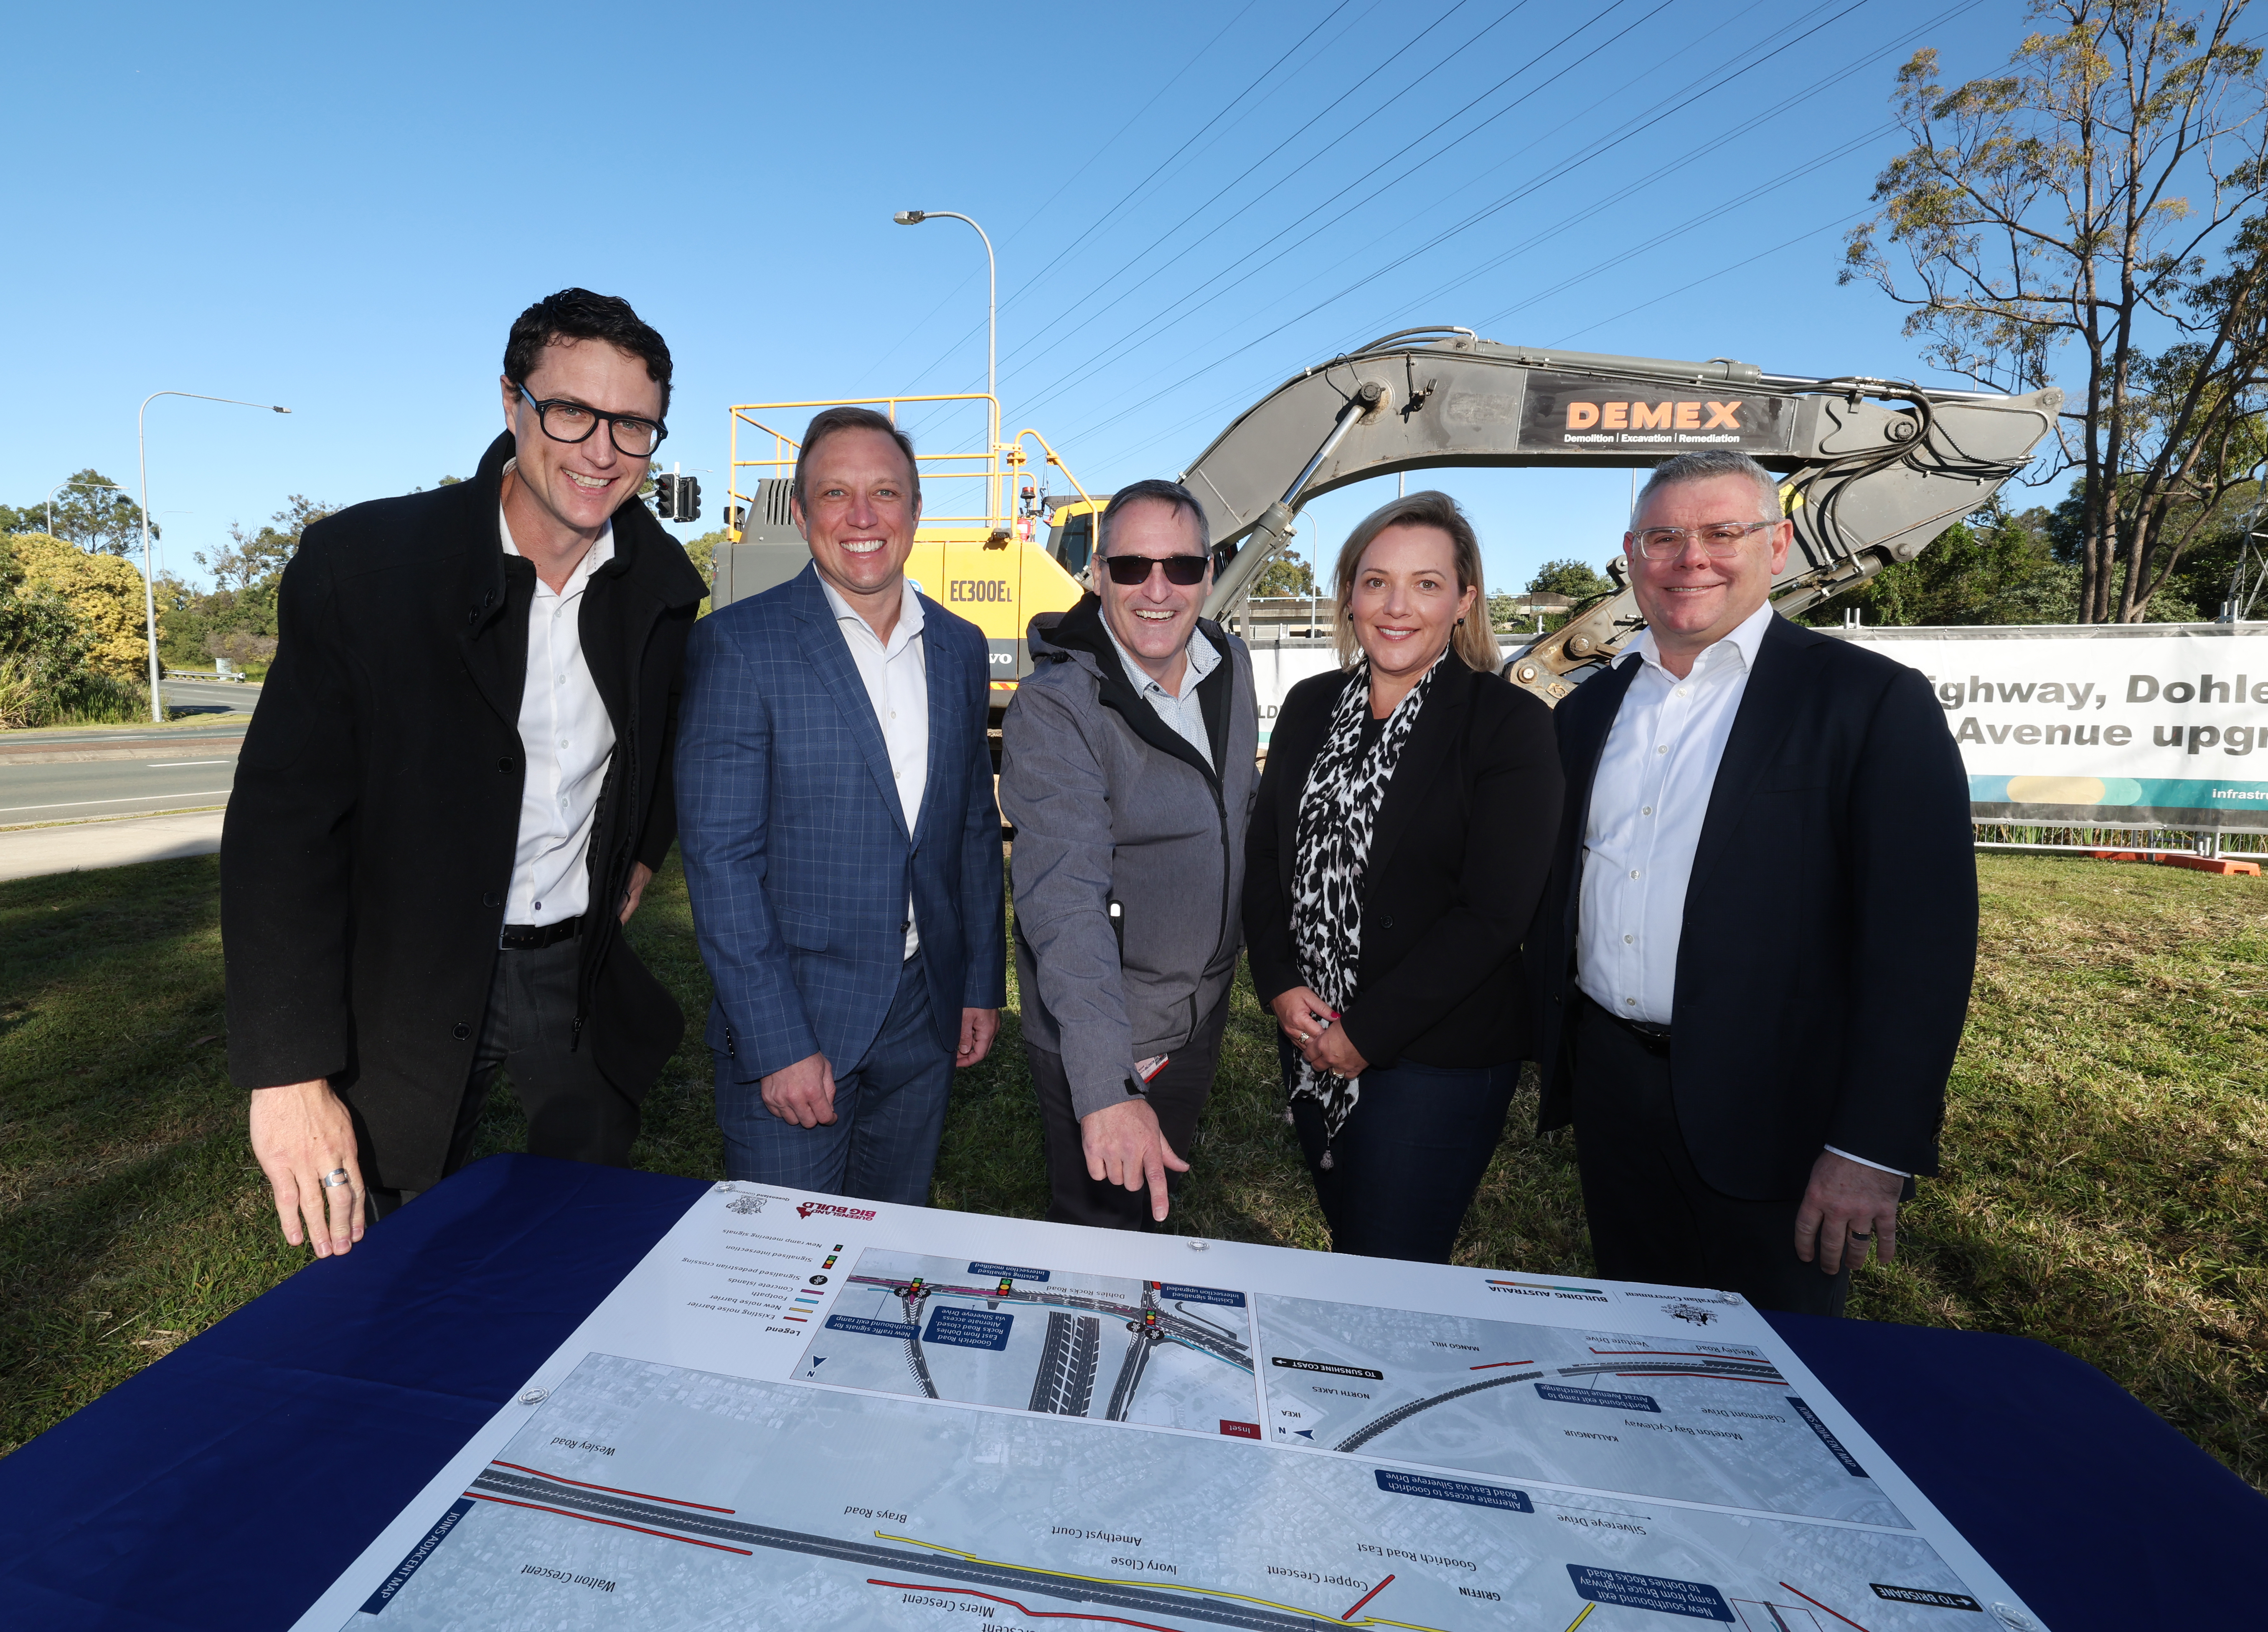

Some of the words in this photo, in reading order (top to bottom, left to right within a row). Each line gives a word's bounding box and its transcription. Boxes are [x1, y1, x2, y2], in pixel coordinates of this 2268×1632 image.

[1566, 402, 1742, 430] DEMEX
[1564, 434, 1614, 442] Demolition
[1621, 434, 1671, 442] Excavation
[1679, 434, 1740, 442] Remediation
[989, 653, 1012, 664] VO
[1927, 675, 2106, 710] ighway,
[1955, 717, 2132, 745] Avenue
[2212, 789, 2268, 800] infrastr
[756, 1193, 790, 1202] Queensland
[802, 1202, 848, 1213] BUILD
[849, 1208, 876, 1218] BIG
[750, 1233, 783, 1242] metering
[726, 1245, 771, 1256] intersection
[681, 1258, 714, 1266] crossing
[772, 1253, 813, 1262] Signalised
[716, 1263, 758, 1273] pedestrian
[1006, 1267, 1045, 1275] intersection
[759, 1270, 801, 1280] Signalised
[727, 1278, 757, 1286] islands
[758, 1283, 793, 1292] Concrete
[751, 1291, 787, 1301] Footpath
[1096, 1290, 1125, 1299] Dohles
[1200, 1290, 1239, 1299] intersection
[1488, 1286, 1550, 1297] AUSTRALIA
[1625, 1292, 1681, 1302] Government
[709, 1295, 738, 1304] barrier
[1554, 1292, 1608, 1303] BUILDING
[1683, 1297, 1727, 1306] ustralian
[687, 1302, 716, 1311] barrier
[741, 1309, 775, 1319] Existing
[962, 1312, 993, 1320] Silvereye
[871, 1321, 914, 1330] southbound
[765, 1327, 801, 1336] Legend
[958, 1337, 991, 1346] Goodrich
[1585, 1335, 1610, 1344] Drive
[1612, 1337, 1649, 1348] Venture
[1449, 1343, 1479, 1352] MANGO
[1696, 1345, 1721, 1353] Road
[1722, 1345, 1757, 1357] Wesley
[1292, 1361, 1318, 1371] COAST
[1320, 1365, 1362, 1377] SUNSHINE
[1312, 1386, 1338, 1396] LAKES
[1341, 1389, 1370, 1400] NORTH
[1541, 1385, 1590, 1396] interchange
[1591, 1391, 1621, 1400] Avenue
[1599, 1399, 1650, 1410] Northbound
[1281, 1409, 1301, 1418] IKEA
[1701, 1408, 1727, 1418] Drive
[1728, 1411, 1785, 1423] Claremont
[1229, 1425, 1250, 1434] Inset
[1624, 1419, 1673, 1432] Cycleway
[1674, 1424, 1694, 1436] Bay
[1564, 1429, 1619, 1442] KALLANGUR
[1697, 1428, 1743, 1441] Moreton
[1796, 1406, 1817, 1423] JOINS
[1812, 1423, 1844, 1452] ADJACENT
[1837, 1452, 1856, 1467] MAP
[550, 1436, 578, 1449] Road
[579, 1441, 616, 1457] Wesley
[1386, 1473, 1409, 1482] Drive
[1412, 1477, 1453, 1489] Silvereye
[1389, 1482, 1431, 1495] Goodrich
[1433, 1489, 1442, 1497] to
[1471, 1486, 1491, 1495] East
[1493, 1489, 1517, 1499] Road
[1444, 1491, 1475, 1502] access
[1478, 1496, 1520, 1509] Alternate
[844, 1506, 873, 1519] Road
[876, 1509, 907, 1524] Brays
[434, 1512, 460, 1535] JOINS
[1557, 1514, 1588, 1527] Drive
[1590, 1518, 1647, 1535] Silvereye
[1051, 1526, 1082, 1539] Court
[1085, 1530, 1142, 1547] Amethyst
[1356, 1543, 1382, 1556] East
[1387, 1548, 1417, 1562] Road
[399, 1535, 439, 1577] ADJACENT
[1111, 1556, 1144, 1570] Close
[1147, 1559, 1177, 1575] Ivory
[1420, 1554, 1477, 1571] Goodrich
[520, 1564, 572, 1584] Crescent
[1267, 1565, 1320, 1584] Crescent
[1586, 1569, 1614, 1581] Road
[1615, 1574, 1646, 1585] Rocks
[381, 1577, 403, 1598] MAP
[574, 1575, 616, 1593] Walton
[1323, 1575, 1368, 1591] Copper
[1580, 1577, 1624, 1593] Highway
[1648, 1579, 1687, 1592] Dohles
[1458, 1586, 1501, 1602] GRIFFIN
[1628, 1585, 1657, 1597] Bruce
[1688, 1584, 1700, 1594] to
[1597, 1591, 1617, 1601] exit
[1661, 1591, 1685, 1601] from
[1688, 1594, 1717, 1605] ramp
[1876, 1587, 1937, 1603] BRISBANE
[1938, 1595, 1958, 1606] TO
[902, 1593, 956, 1612] Crescent
[1620, 1594, 1685, 1612] southbound
[959, 1602, 995, 1618] Miers
[1688, 1605, 1714, 1617] New
[982, 1623, 1035, 1632] scent
